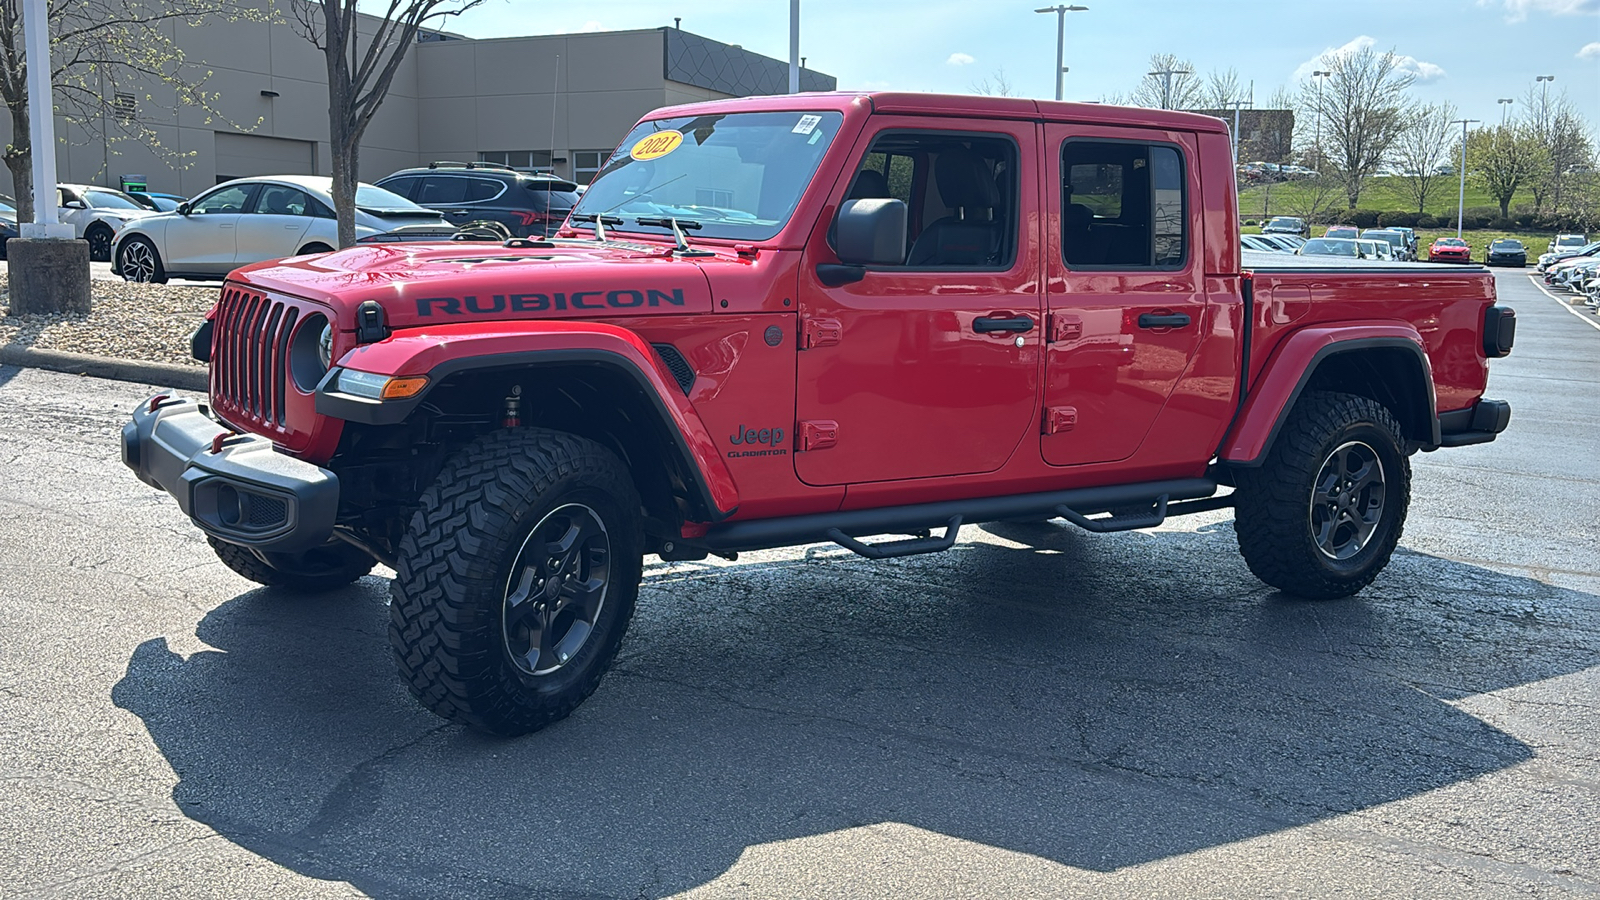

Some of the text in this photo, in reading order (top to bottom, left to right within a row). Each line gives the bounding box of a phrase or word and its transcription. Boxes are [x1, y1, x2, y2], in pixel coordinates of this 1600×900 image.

[635, 135, 678, 156] 2021
[416, 288, 685, 317] RUBICON
[729, 424, 784, 448] Jeep
[727, 449, 787, 458] GLADIATOR
